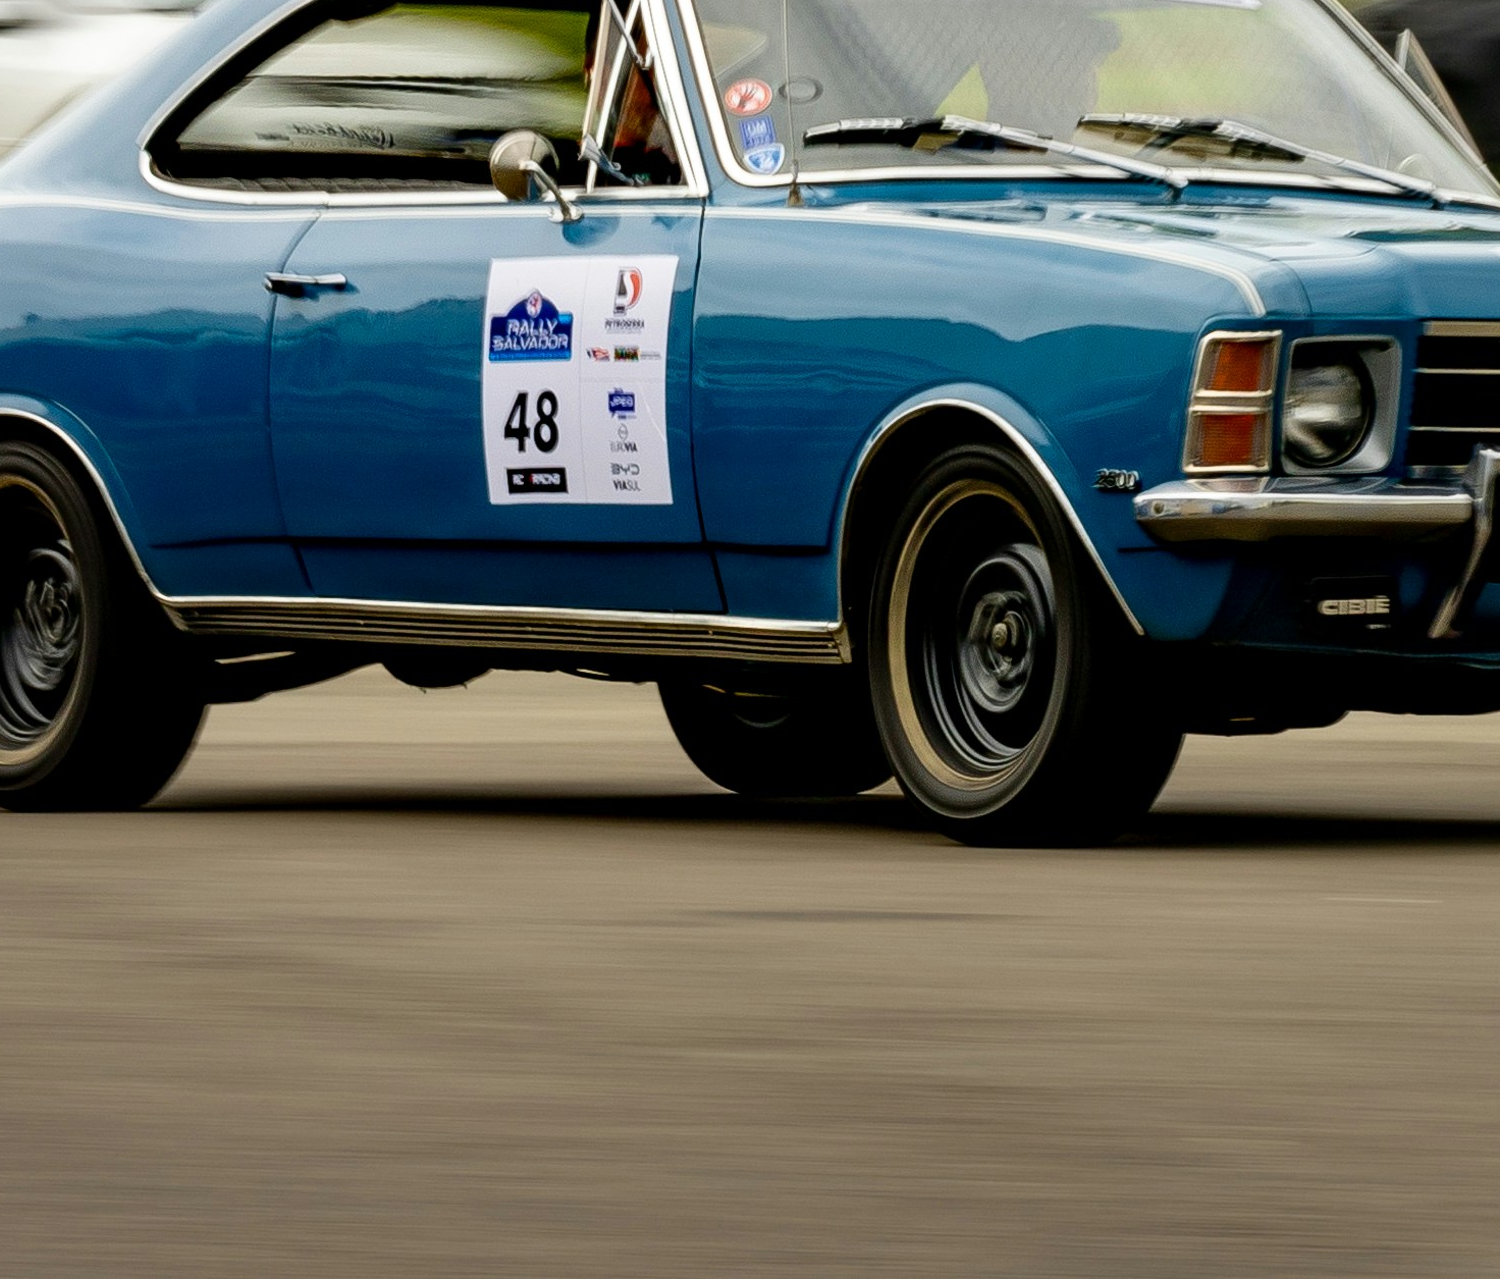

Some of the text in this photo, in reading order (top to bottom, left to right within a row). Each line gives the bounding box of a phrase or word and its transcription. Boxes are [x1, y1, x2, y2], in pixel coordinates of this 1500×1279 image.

[507, 318, 558, 337] RALLY
[492, 333, 569, 352] SALVADOR
[504, 390, 559, 454] 48
[610, 463, 640, 475] BYD
[612, 479, 641, 491] VIASUL
